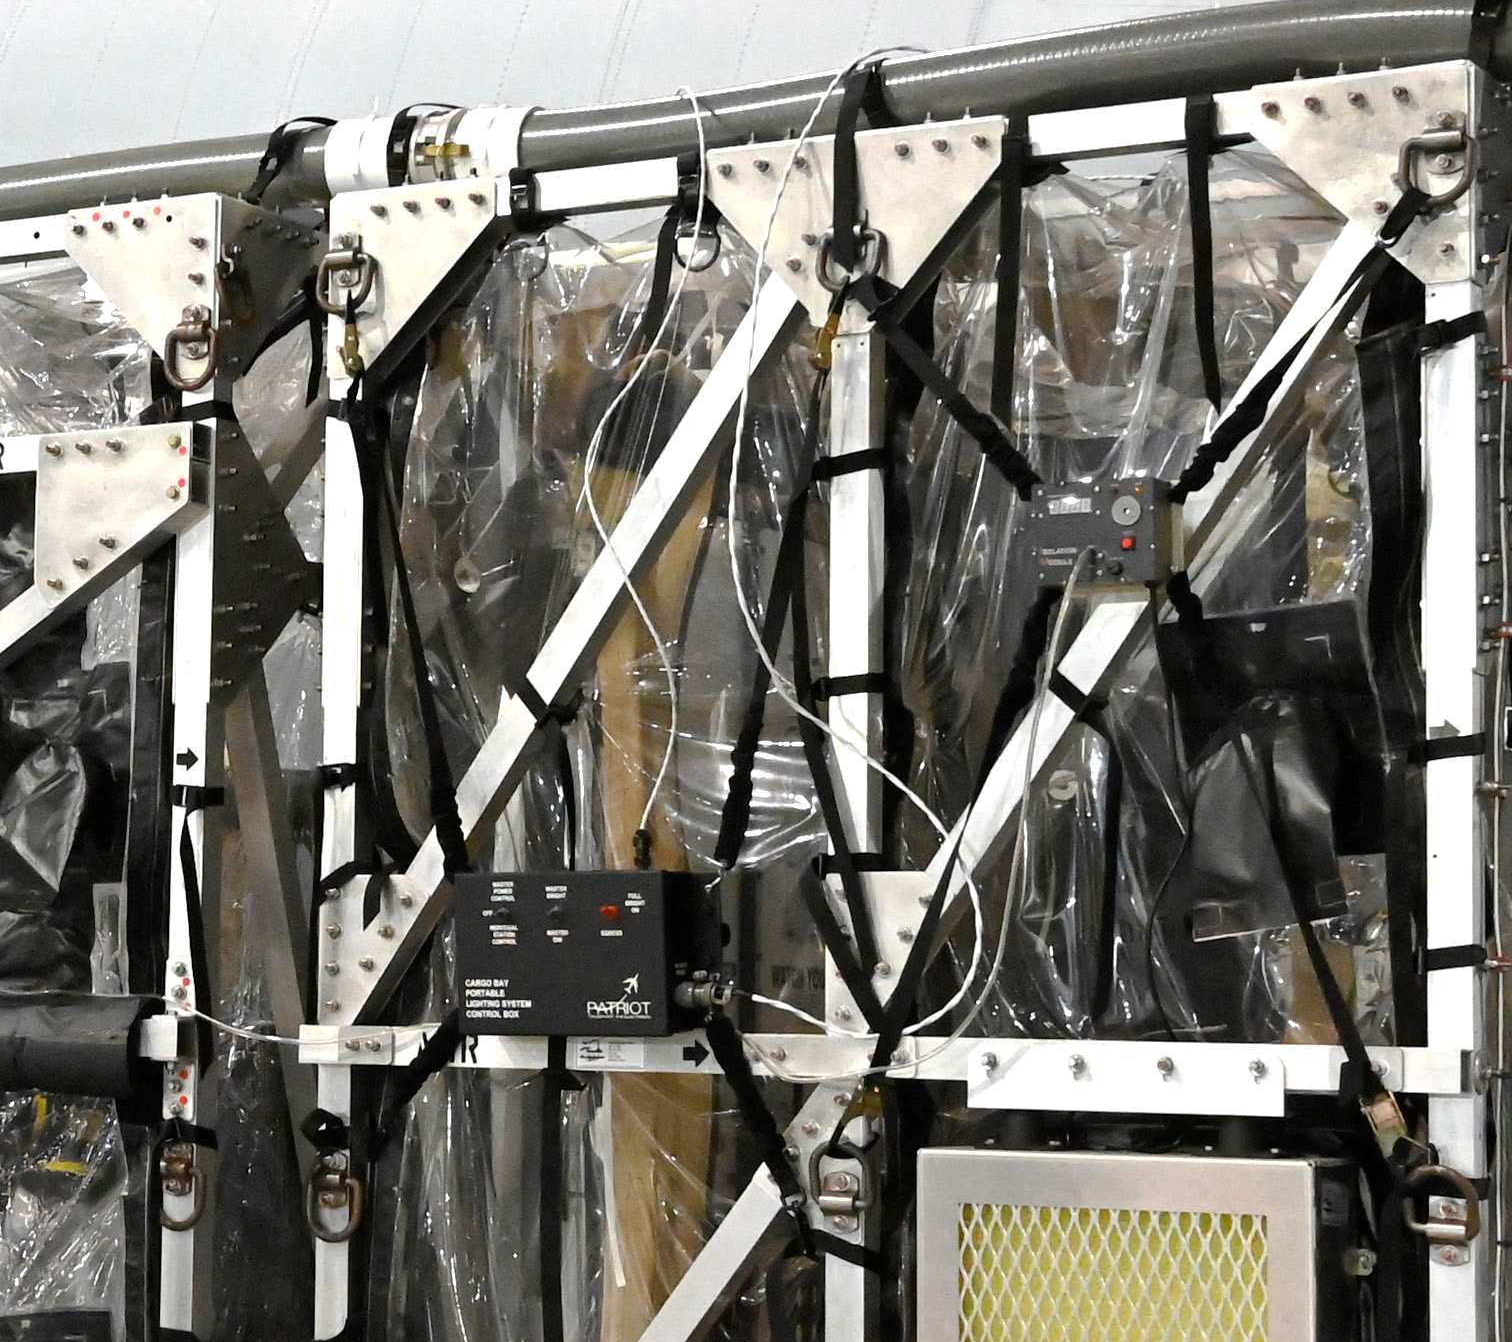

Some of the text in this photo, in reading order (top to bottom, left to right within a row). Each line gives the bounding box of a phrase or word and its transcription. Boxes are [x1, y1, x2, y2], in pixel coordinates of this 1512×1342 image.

[465, 979, 509, 987] CARGO BAY
[466, 989, 506, 997] PORTABLE
[466, 1000, 532, 1008] LIGHTING SYSTEM
[587, 1001, 652, 1015] PATRIOT
[466, 1010, 520, 1018] CONTROL BOX
